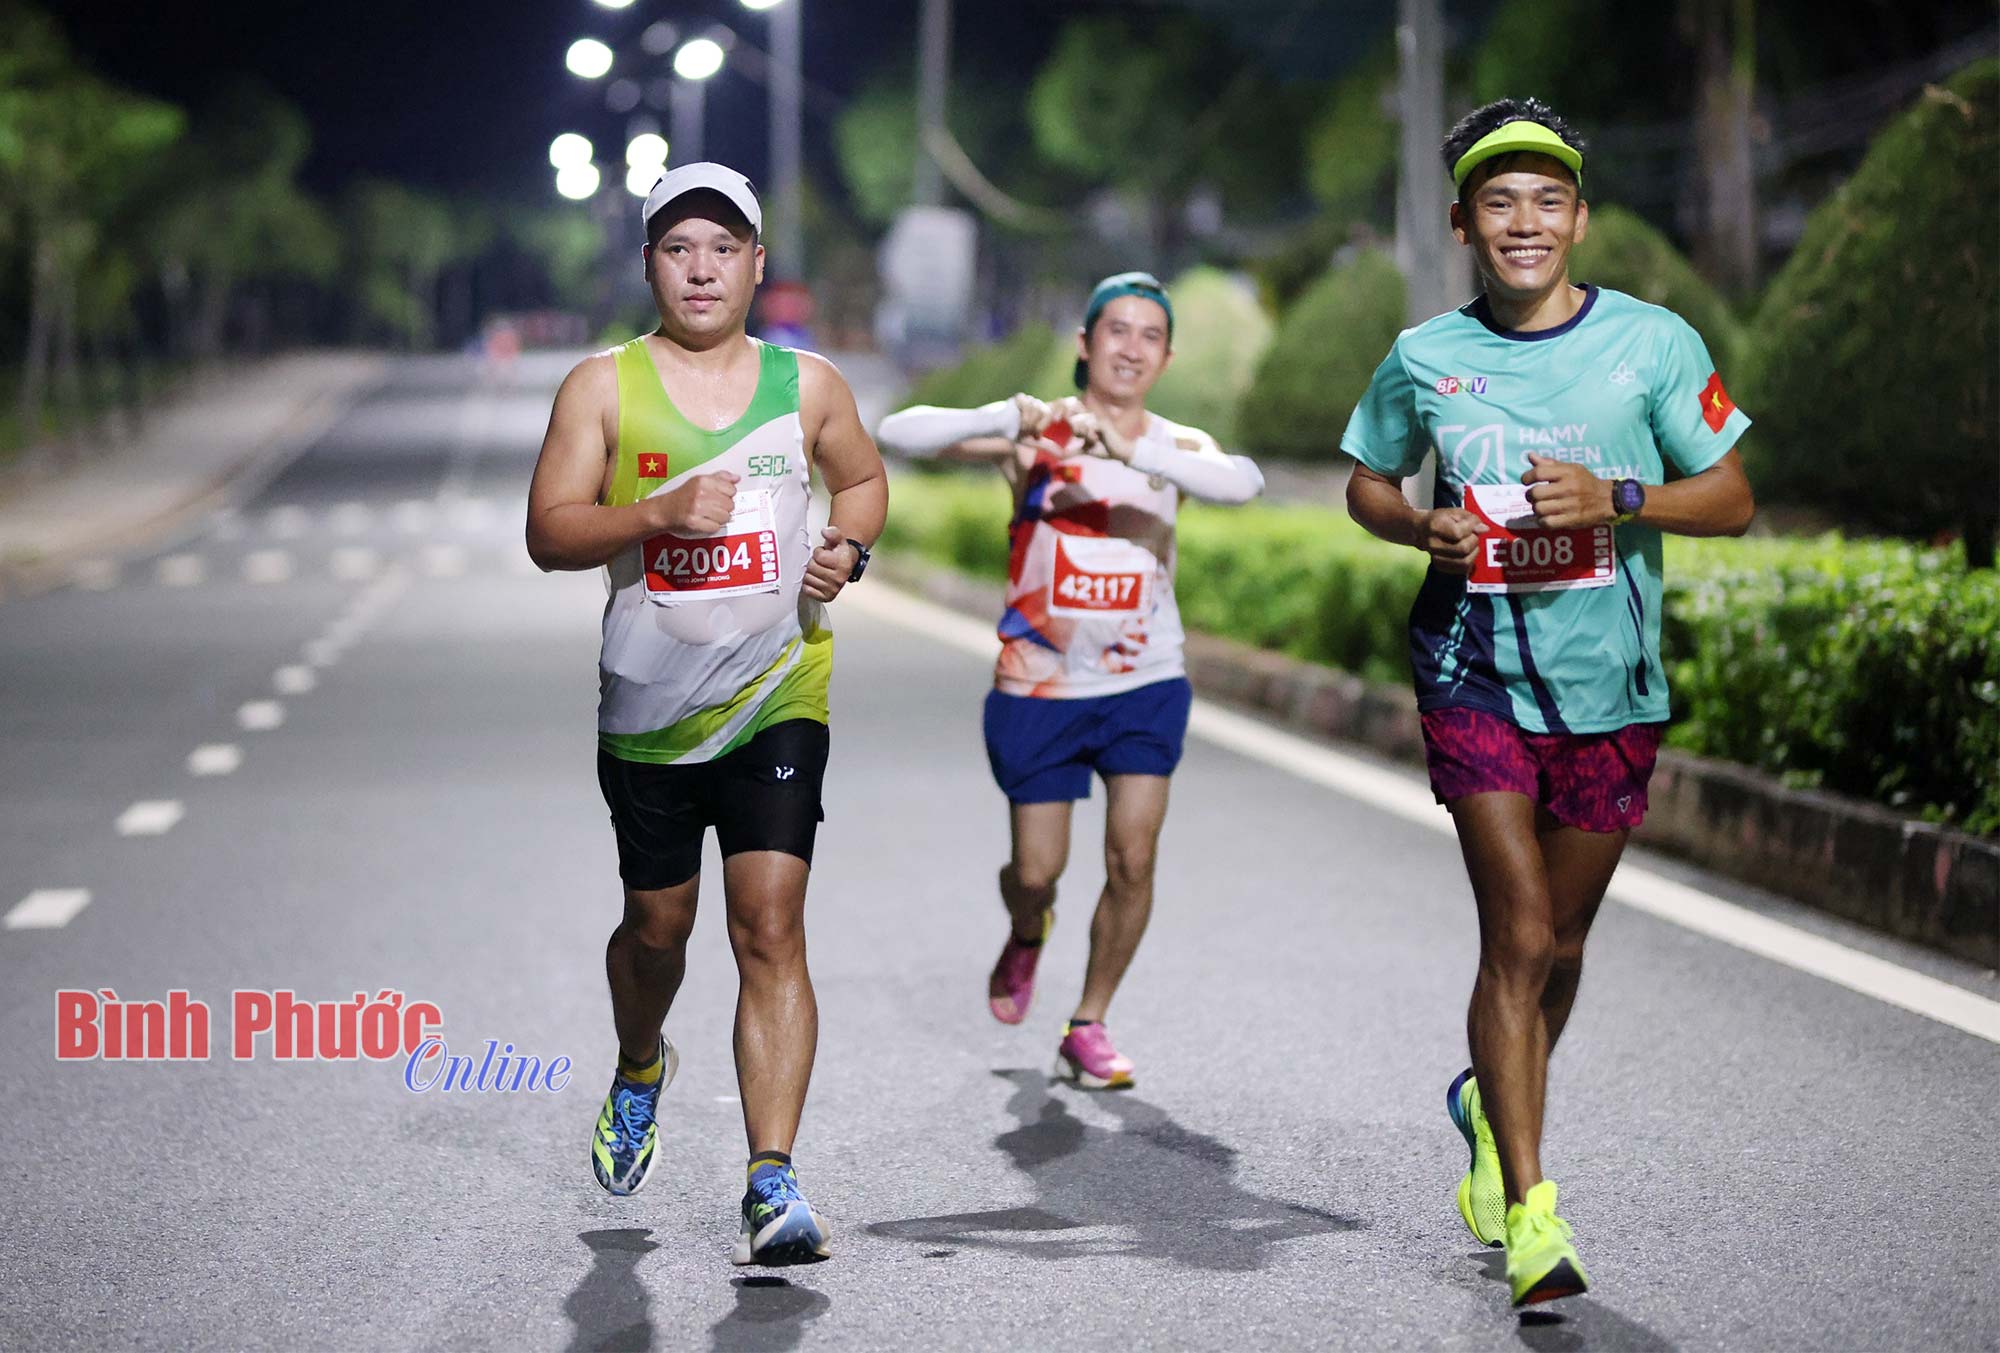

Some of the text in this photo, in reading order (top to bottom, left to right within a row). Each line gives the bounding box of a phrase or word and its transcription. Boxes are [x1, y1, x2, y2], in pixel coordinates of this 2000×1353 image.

[1436, 376, 1488, 394] BPTV
[1519, 424, 1588, 445] HAMY
[654, 542, 751, 576] 42004
[1486, 535, 1575, 568] E008
[707, 574, 730, 583] TRUONG
[1058, 574, 1136, 601] 42117
